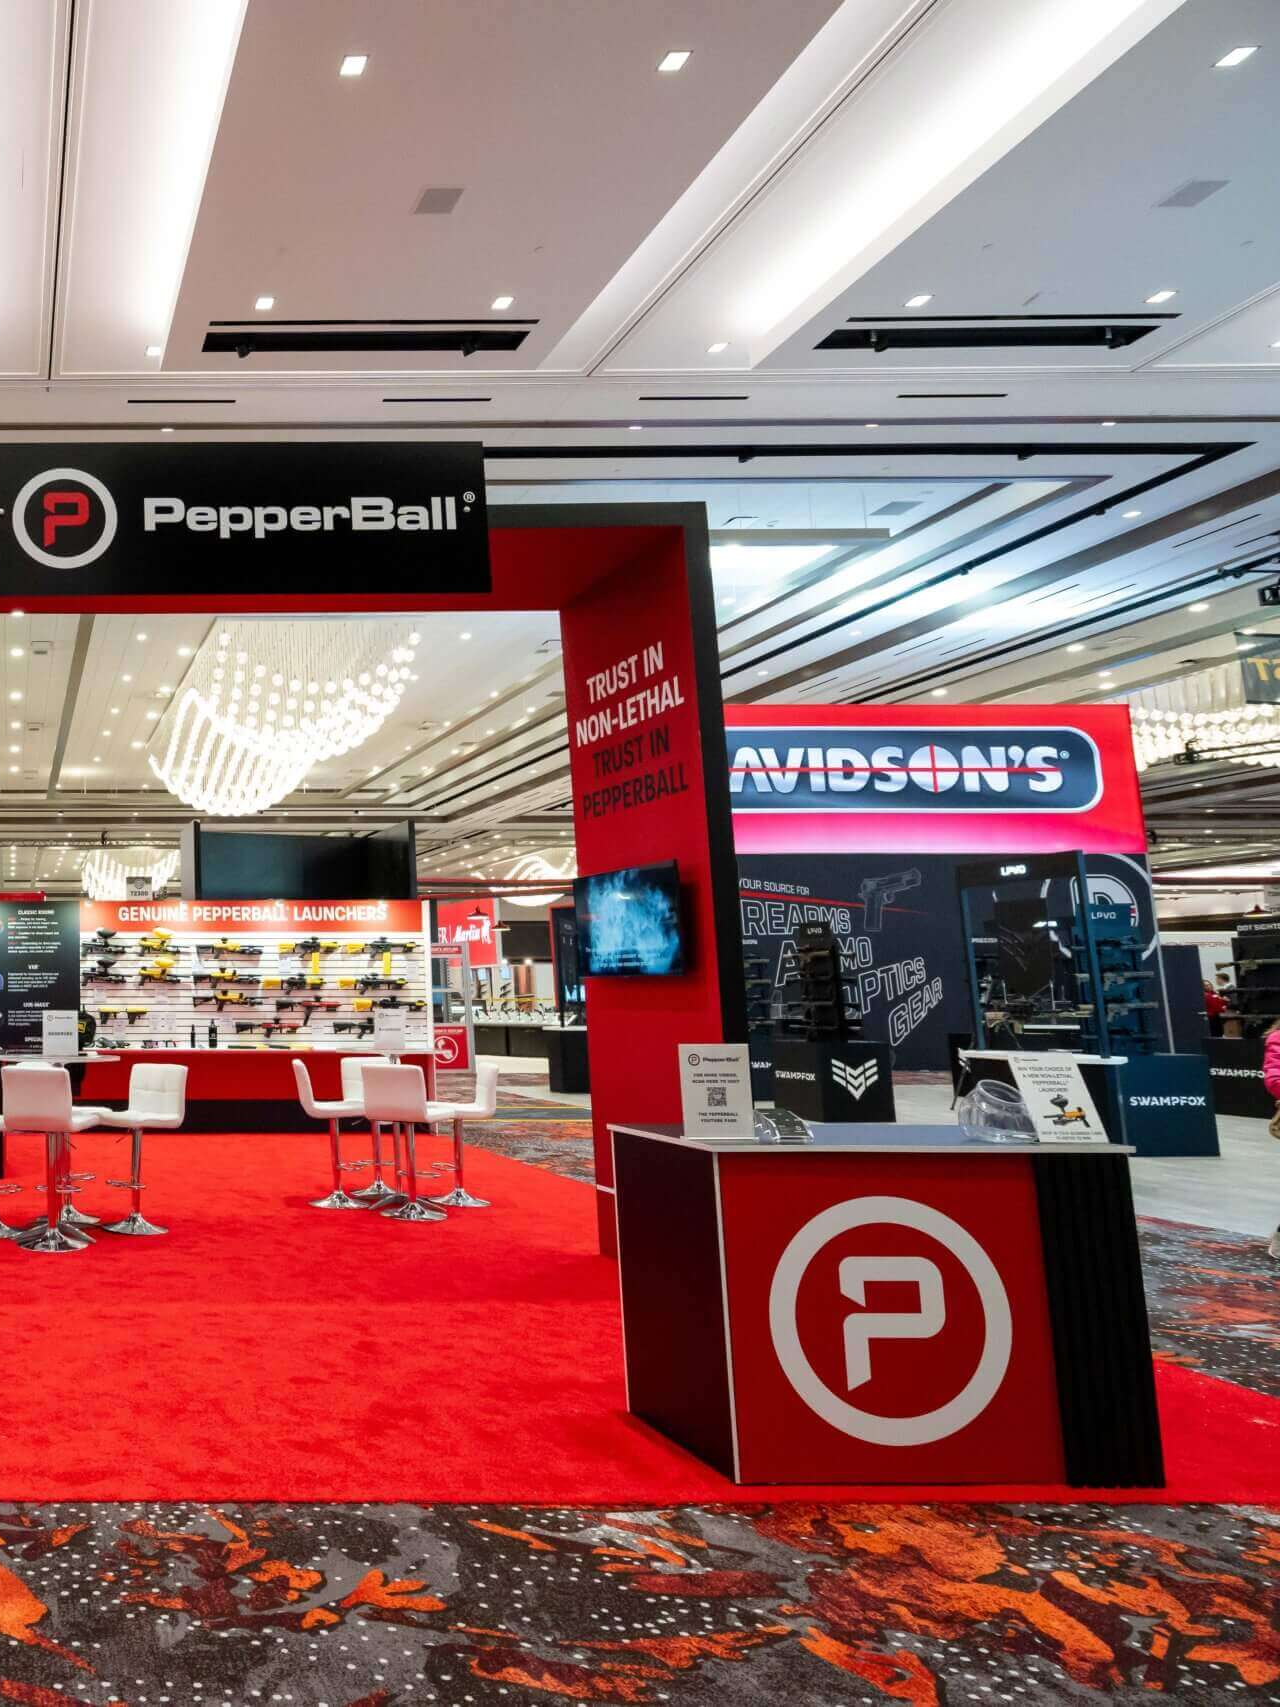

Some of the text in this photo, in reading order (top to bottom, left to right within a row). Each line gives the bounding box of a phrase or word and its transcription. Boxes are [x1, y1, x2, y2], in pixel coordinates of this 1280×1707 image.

[586, 641, 664, 704] TRUST IN
[576, 675, 685, 748] NON-LETHAL
[592, 727, 669, 780] TRUST IN
[583, 762, 689, 820] PEPPERBALL
[763, 881, 795, 894] SOURCE
[797, 886, 810, 896] FOR
[118, 905, 387, 922] GENUINE PEPPERBALL LAUNCHERS
[740, 899, 852, 936] REARMS
[774, 936, 873, 988] AMO
[888, 977, 943, 1047] GEAR
[775, 1070, 816, 1080] SWAMPFOX
[1210, 1067, 1265, 1078] SWAMPFO
[1129, 1096, 1206, 1106] SWAMPFOX
